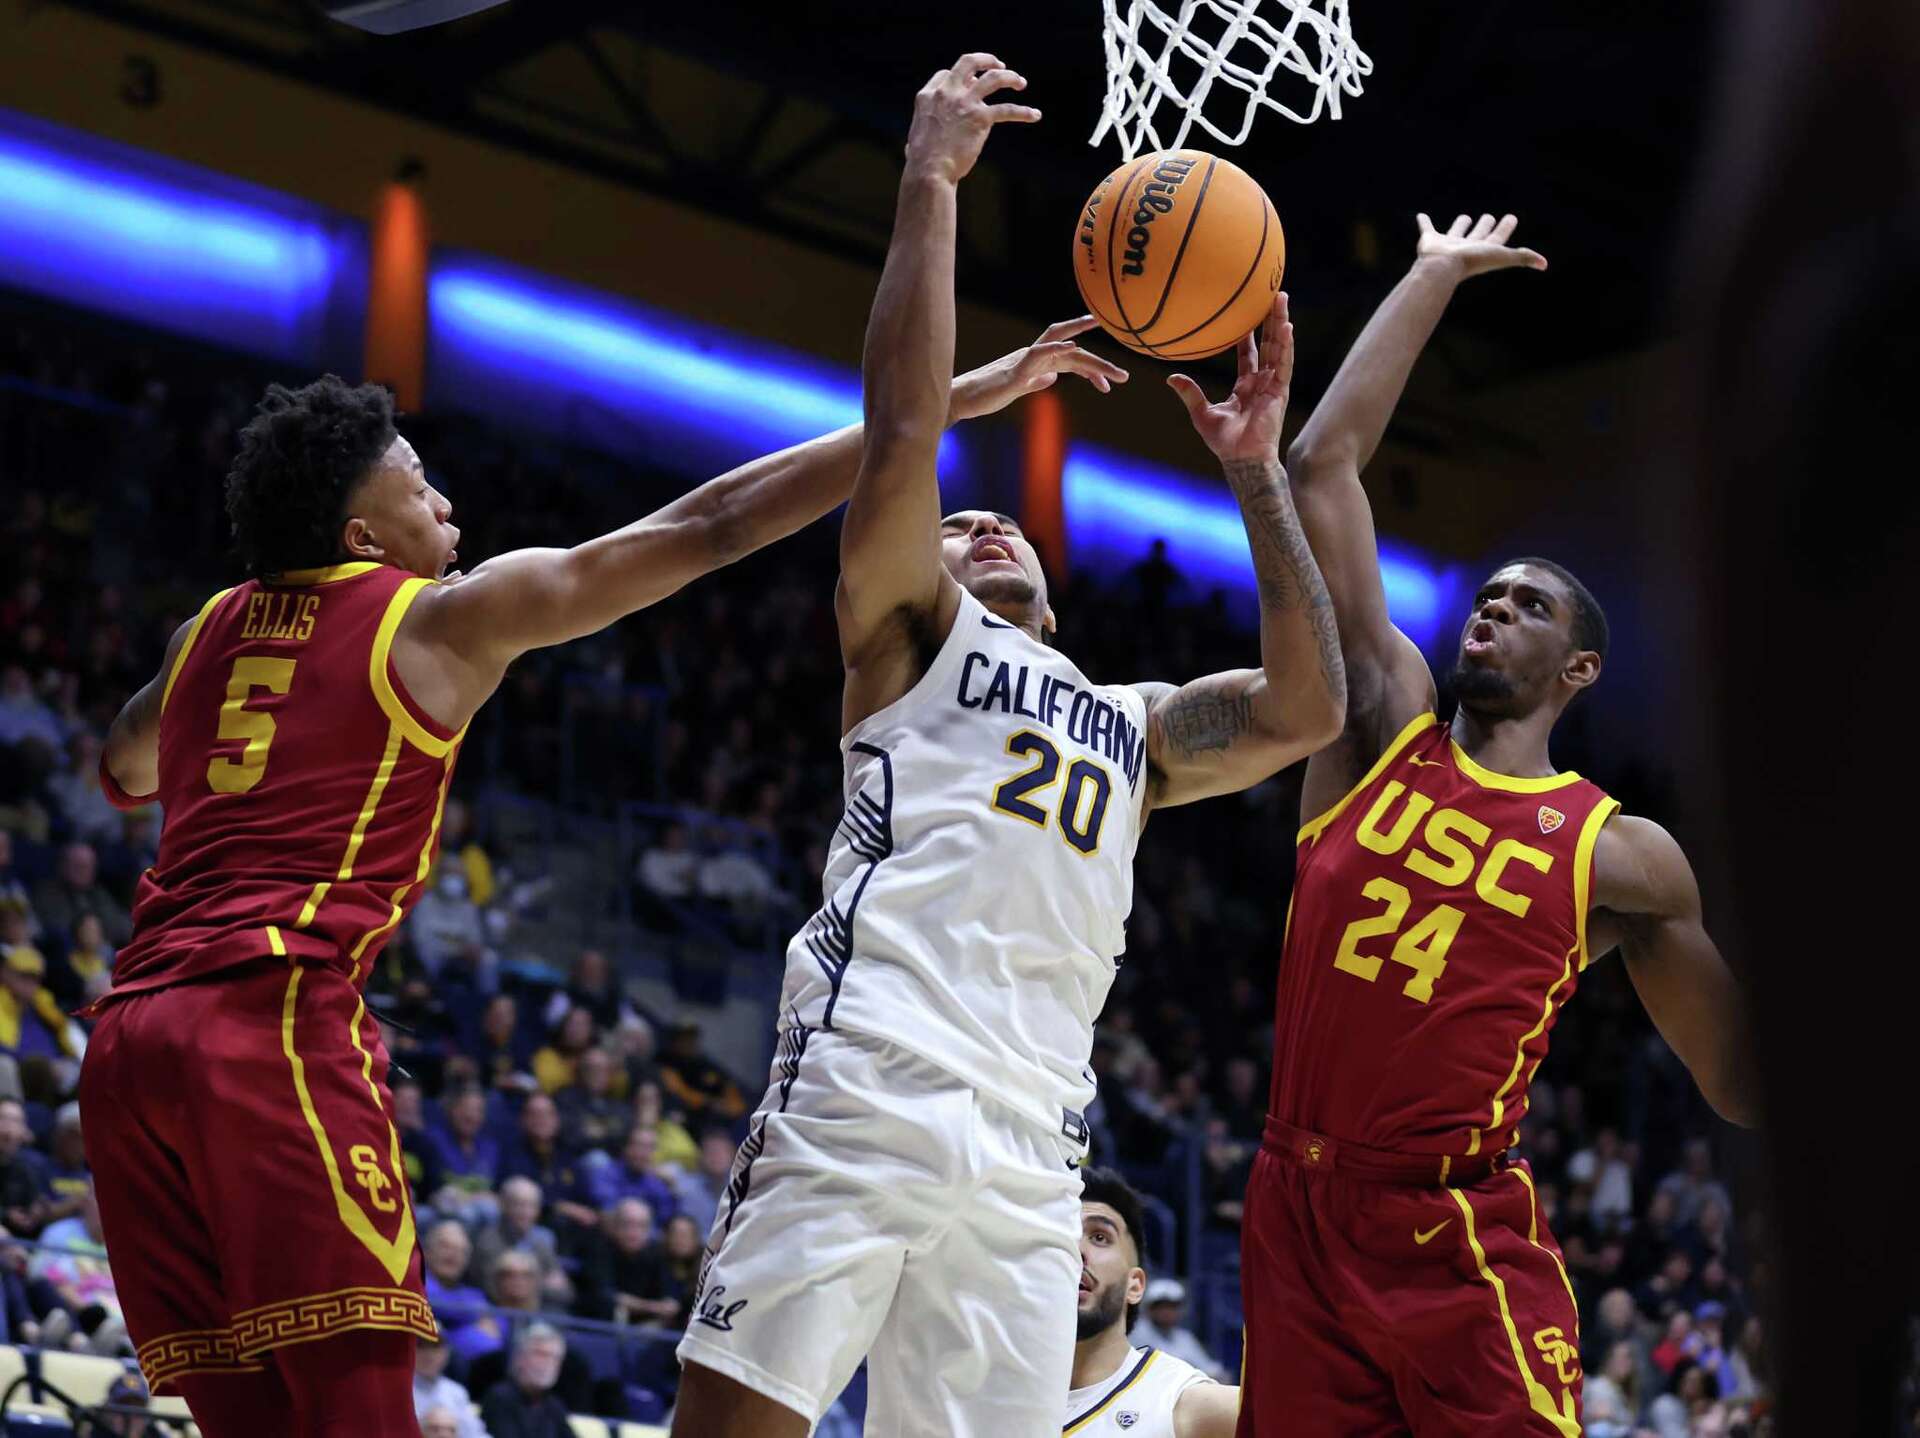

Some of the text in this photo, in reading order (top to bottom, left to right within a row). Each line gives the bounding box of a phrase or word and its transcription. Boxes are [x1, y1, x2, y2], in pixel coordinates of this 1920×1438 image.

[1121, 158, 1199, 277] Wilson
[241, 592, 321, 640] ELLIS
[207, 657, 297, 794] 5
[991, 728, 1112, 858] 20
[1356, 780, 1554, 918] USC
[1334, 877, 1467, 1005] 24
[350, 1144, 396, 1213] SC
[1533, 1326, 1578, 1384] SC
